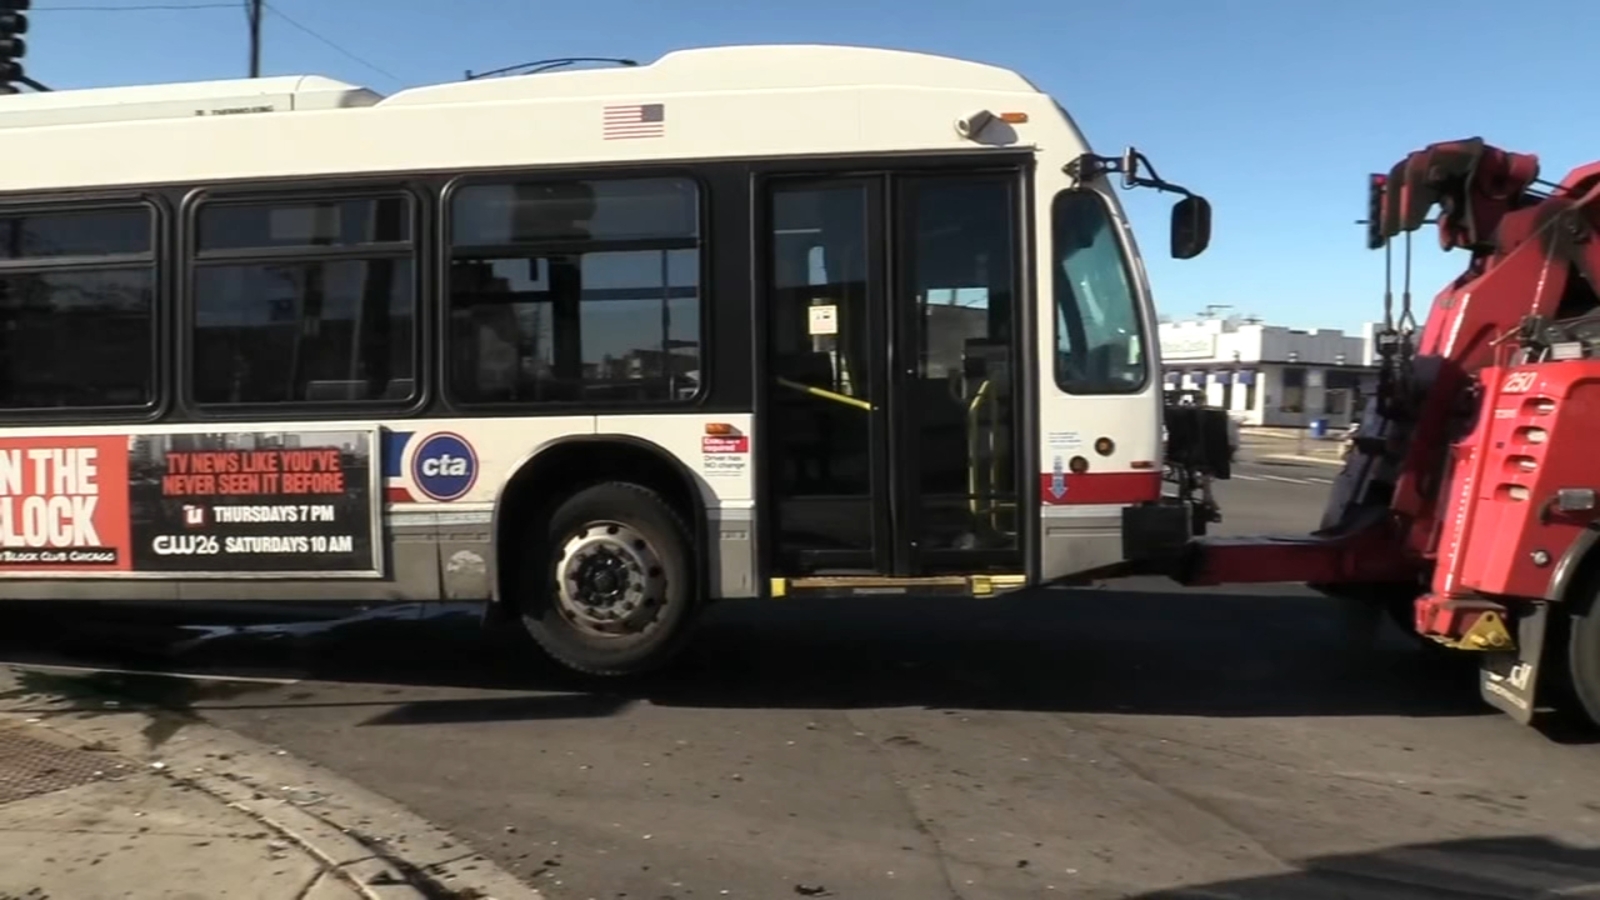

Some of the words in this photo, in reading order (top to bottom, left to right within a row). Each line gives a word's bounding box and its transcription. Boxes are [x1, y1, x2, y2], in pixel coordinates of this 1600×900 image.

[1502, 372, 1538, 392] 250
[0, 449, 22, 495] N
[28, 448, 98, 495] THE
[167, 453, 188, 473] TV
[191, 452, 239, 473] NEWS
[242, 452, 278, 472] LIKE
[281, 450, 340, 472] YOU'VE
[422, 454, 467, 476] cta
[163, 475, 216, 495] NEVER
[219, 474, 260, 494] SEEN
[263, 474, 279, 493] IT
[282, 472, 344, 493] BEFORE
[0, 495, 101, 547] LOCK
[212, 506, 298, 522] THURSDAYS
[299, 506, 309, 521] 7
[311, 505, 335, 521] PM
[225, 536, 309, 553] SATURDAYS
[310, 536, 327, 552] 10
[328, 535, 353, 552] AM
